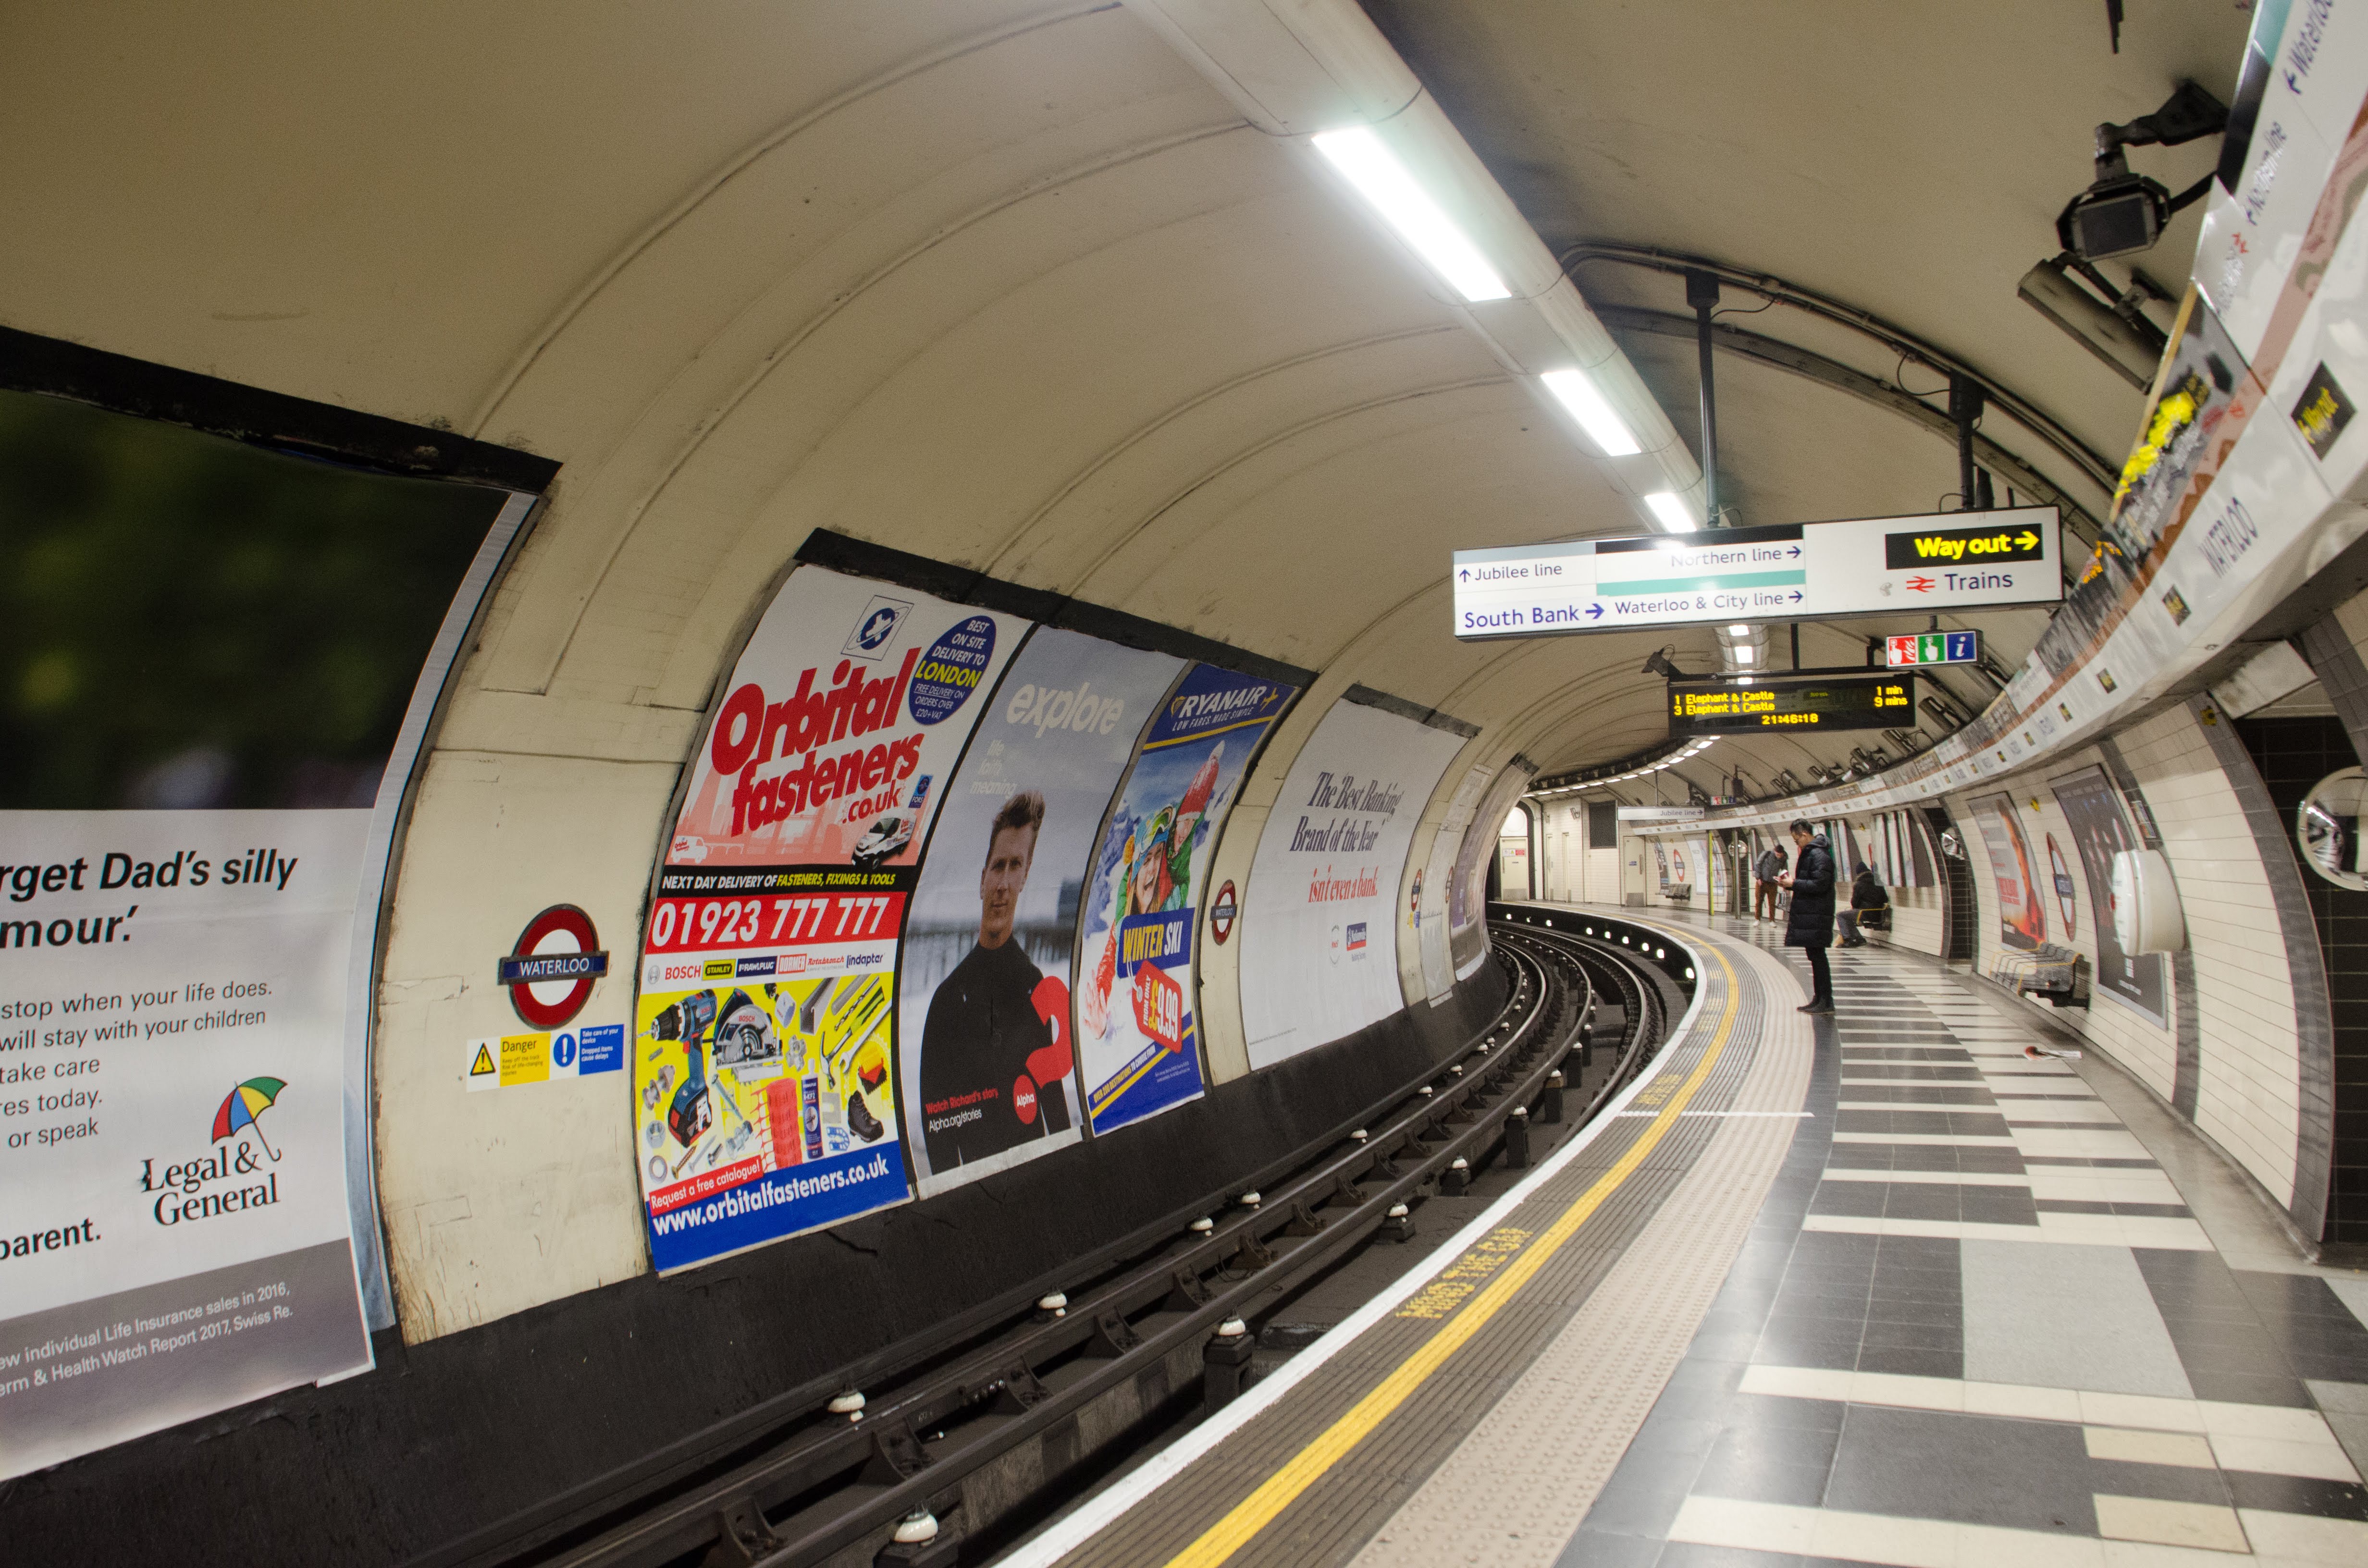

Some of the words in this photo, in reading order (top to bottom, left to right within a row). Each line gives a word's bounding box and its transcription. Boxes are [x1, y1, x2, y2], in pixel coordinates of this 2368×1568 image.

[1671, 551, 1746, 567] Northern
[1752, 547, 1783, 562] line
[1914, 536, 1966, 560] Way
[1969, 534, 2011, 554] out
[1474, 565, 1531, 582] Jubilee
[1534, 563, 1562, 576] line
[1945, 572, 2013, 591] Trains
[1615, 597, 1690, 615] Waterloo
[1696, 596, 1707, 610] &
[1714, 592, 1748, 612] City
[1754, 591, 1784, 607] line
[966, 620, 990, 634] BEST
[1464, 608, 1524, 629] South
[1532, 605, 1580, 623] Bank
[951, 633, 969, 646] ON
[966, 637, 987, 649] SITE
[932, 646, 974, 664] DELIVERY
[972, 654, 985, 665] TO
[914, 660, 982, 688] LONDON
[914, 683, 930, 693] FREE
[928, 686, 954, 698] DELIVERY
[954, 690, 965, 699] ON
[915, 696, 939, 707] ORDERS
[938, 700, 954, 710] OVER
[1179, 686, 1267, 718] RYANAIR
[1675, 695, 1680, 705] 1
[1686, 692, 1729, 705] Elephant
[1732, 692, 1739, 702] &
[1742, 691, 1775, 702] Castle
[1876, 686, 1882, 696] 1
[1886, 685, 1903, 696] min
[712, 647, 922, 775] Orbital
[1007, 682, 1125, 739] explore
[1674, 705, 1682, 715] 3
[1686, 703, 1729, 716] Elephant
[1732, 703, 1740, 713] &
[1742, 701, 1775, 712] Castle
[1874, 697, 1883, 707] 9
[1885, 695, 1908, 706] mins
[1172, 722, 1189, 732] LOW
[1212, 711, 1231, 723] MADE
[1762, 714, 1819, 725] 21:46:18
[731, 734, 925, 837] fasteners
[1307, 771, 1337, 808] The
[1358, 779, 1405, 822] Banking
[842, 779, 902, 824] .co.uk
[1289, 816, 1336, 852] Brand
[1329, 818, 1349, 852] of
[1341, 819, 1360, 852] the
[0, 857, 88, 902] rget
[99, 850, 210, 890] Dad's
[222, 848, 298, 891] silly
[662, 875, 694, 889] NEXT
[694, 876, 718, 889] DAY
[717, 875, 765, 889] DELIVERY
[765, 874, 778, 887] OF
[777, 873, 824, 887] FASTENERS,
[826, 873, 861, 885] FIXINGS
[861, 874, 867, 885] &
[868, 873, 896, 885] TOOLS
[1307, 864, 1332, 903] isn't
[1330, 880, 1352, 901] even
[1351, 879, 1357, 899] a
[652, 900, 763, 947] 01923
[770, 898, 830, 939] 777
[834, 897, 891, 936] 777
[1215, 909, 1233, 917] WATERLOO
[1123, 924, 1165, 964] WINTER
[1164, 921, 1183, 956] SKI
[520, 958, 590, 976] WATERLOO
[665, 965, 701, 980] BOSCH
[706, 965, 732, 975] STANLEY
[846, 953, 884, 969] lindapter
[0, 1000, 53, 1020] stop
[62, 993, 123, 1014] when
[131, 988, 178, 1011] your
[184, 984, 215, 1003] life
[222, 980, 272, 1000] does.
[1148, 979, 1179, 1042] £9.99
[0, 1029, 36, 1052] will
[43, 1029, 88, 1048] stay
[95, 1020, 138, 1042] with
[145, 1017, 189, 1041] your
[194, 1010, 267, 1031] children
[502, 1039, 537, 1053] Danger
[581, 1047, 600, 1055] Dropped
[594, 1053, 609, 1061] delays
[0, 1062, 46, 1084] take
[54, 1058, 101, 1078] care
[0, 1098, 30, 1116] es
[37, 1088, 103, 1112] today.
[982, 1088, 999, 1100] story
[1016, 1093, 1035, 1108] Alpha
[929, 1108, 982, 1133] Alpha.org/stories
[8, 1131, 32, 1149] or
[37, 1118, 99, 1147] speak
[141, 1146, 230, 1193] Legal
[234, 1140, 263, 1174] &
[651, 1185, 687, 1211] Request
[689, 1185, 695, 1196] a
[696, 1176, 715, 1194] free
[716, 1160, 760, 1188] catalogue!
[653, 1153, 889, 1237] www.orbitalfasteners.co.uk
[154, 1173, 281, 1226] General
[1395, 1281, 1476, 1320] MIND
[1442, 1253, 1508, 1280] THE
[1477, 1227, 1534, 1252] GAP
[25, 1328, 101, 1364] individual
[105, 1323, 132, 1344] Life
[135, 1304, 204, 1335] Insurance
[206, 1296, 240, 1316] sales
[242, 1290, 255, 1306] in
[257, 1281, 291, 1302] 2016,
[34, 1368, 48, 1386] &
[51, 1355, 100, 1382] Health
[101, 1343, 147, 1367] Watch
[150, 1329, 198, 1355] Report
[199, 1320, 232, 1342] 2017,
[234, 1311, 271, 1332] Swiss
[273, 1304, 294, 1320] Re.
